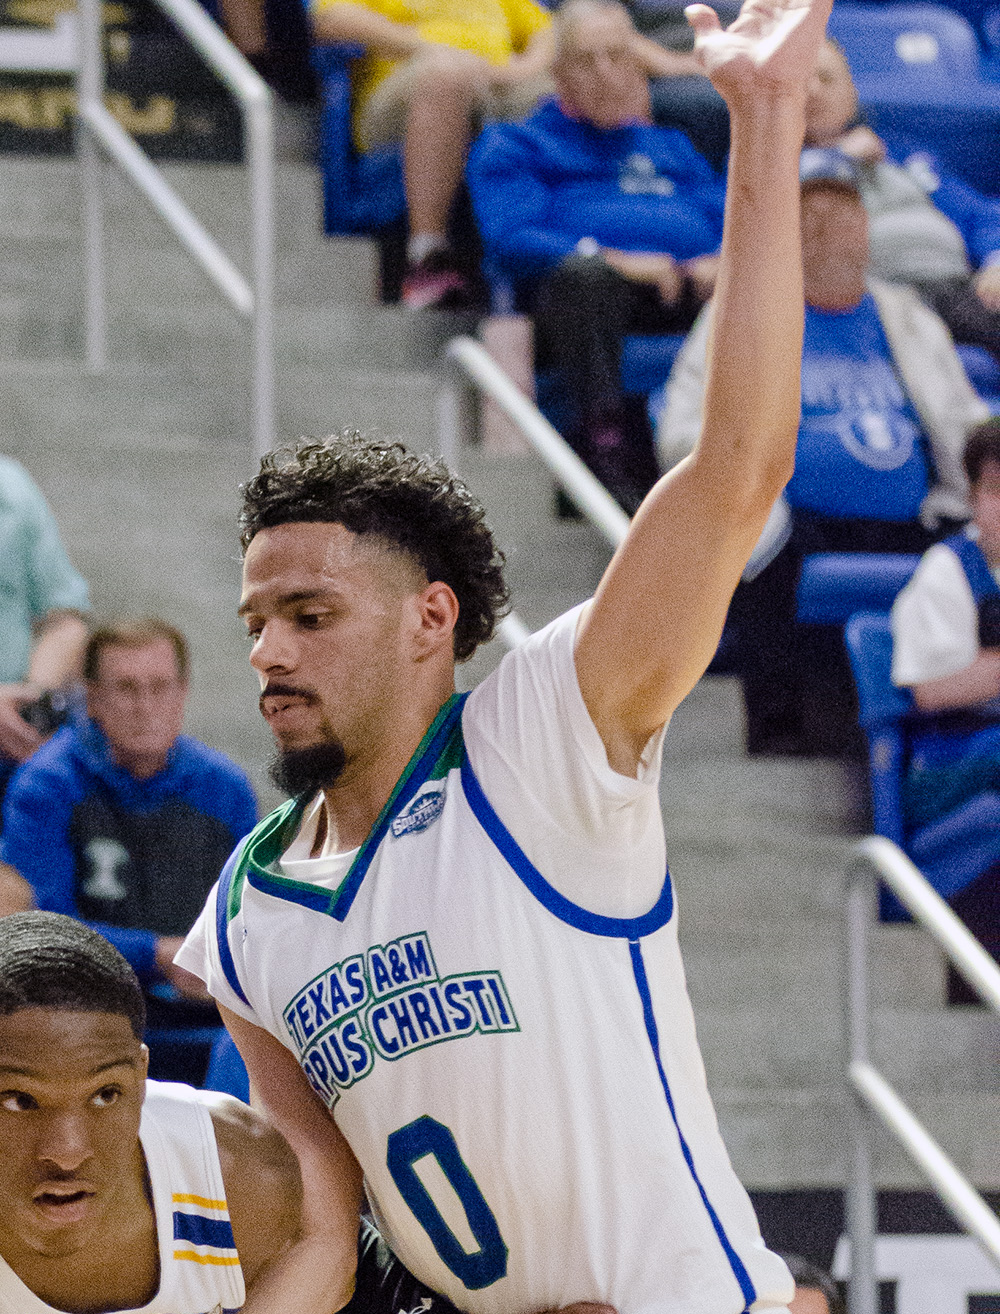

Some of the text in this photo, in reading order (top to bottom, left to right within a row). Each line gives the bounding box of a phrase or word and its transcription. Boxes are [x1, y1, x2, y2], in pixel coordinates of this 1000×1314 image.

[286, 940, 432, 1048] TEXAS A&M
[372, 978, 511, 1054] CHRISTI
[386, 1114, 509, 1291] 0
